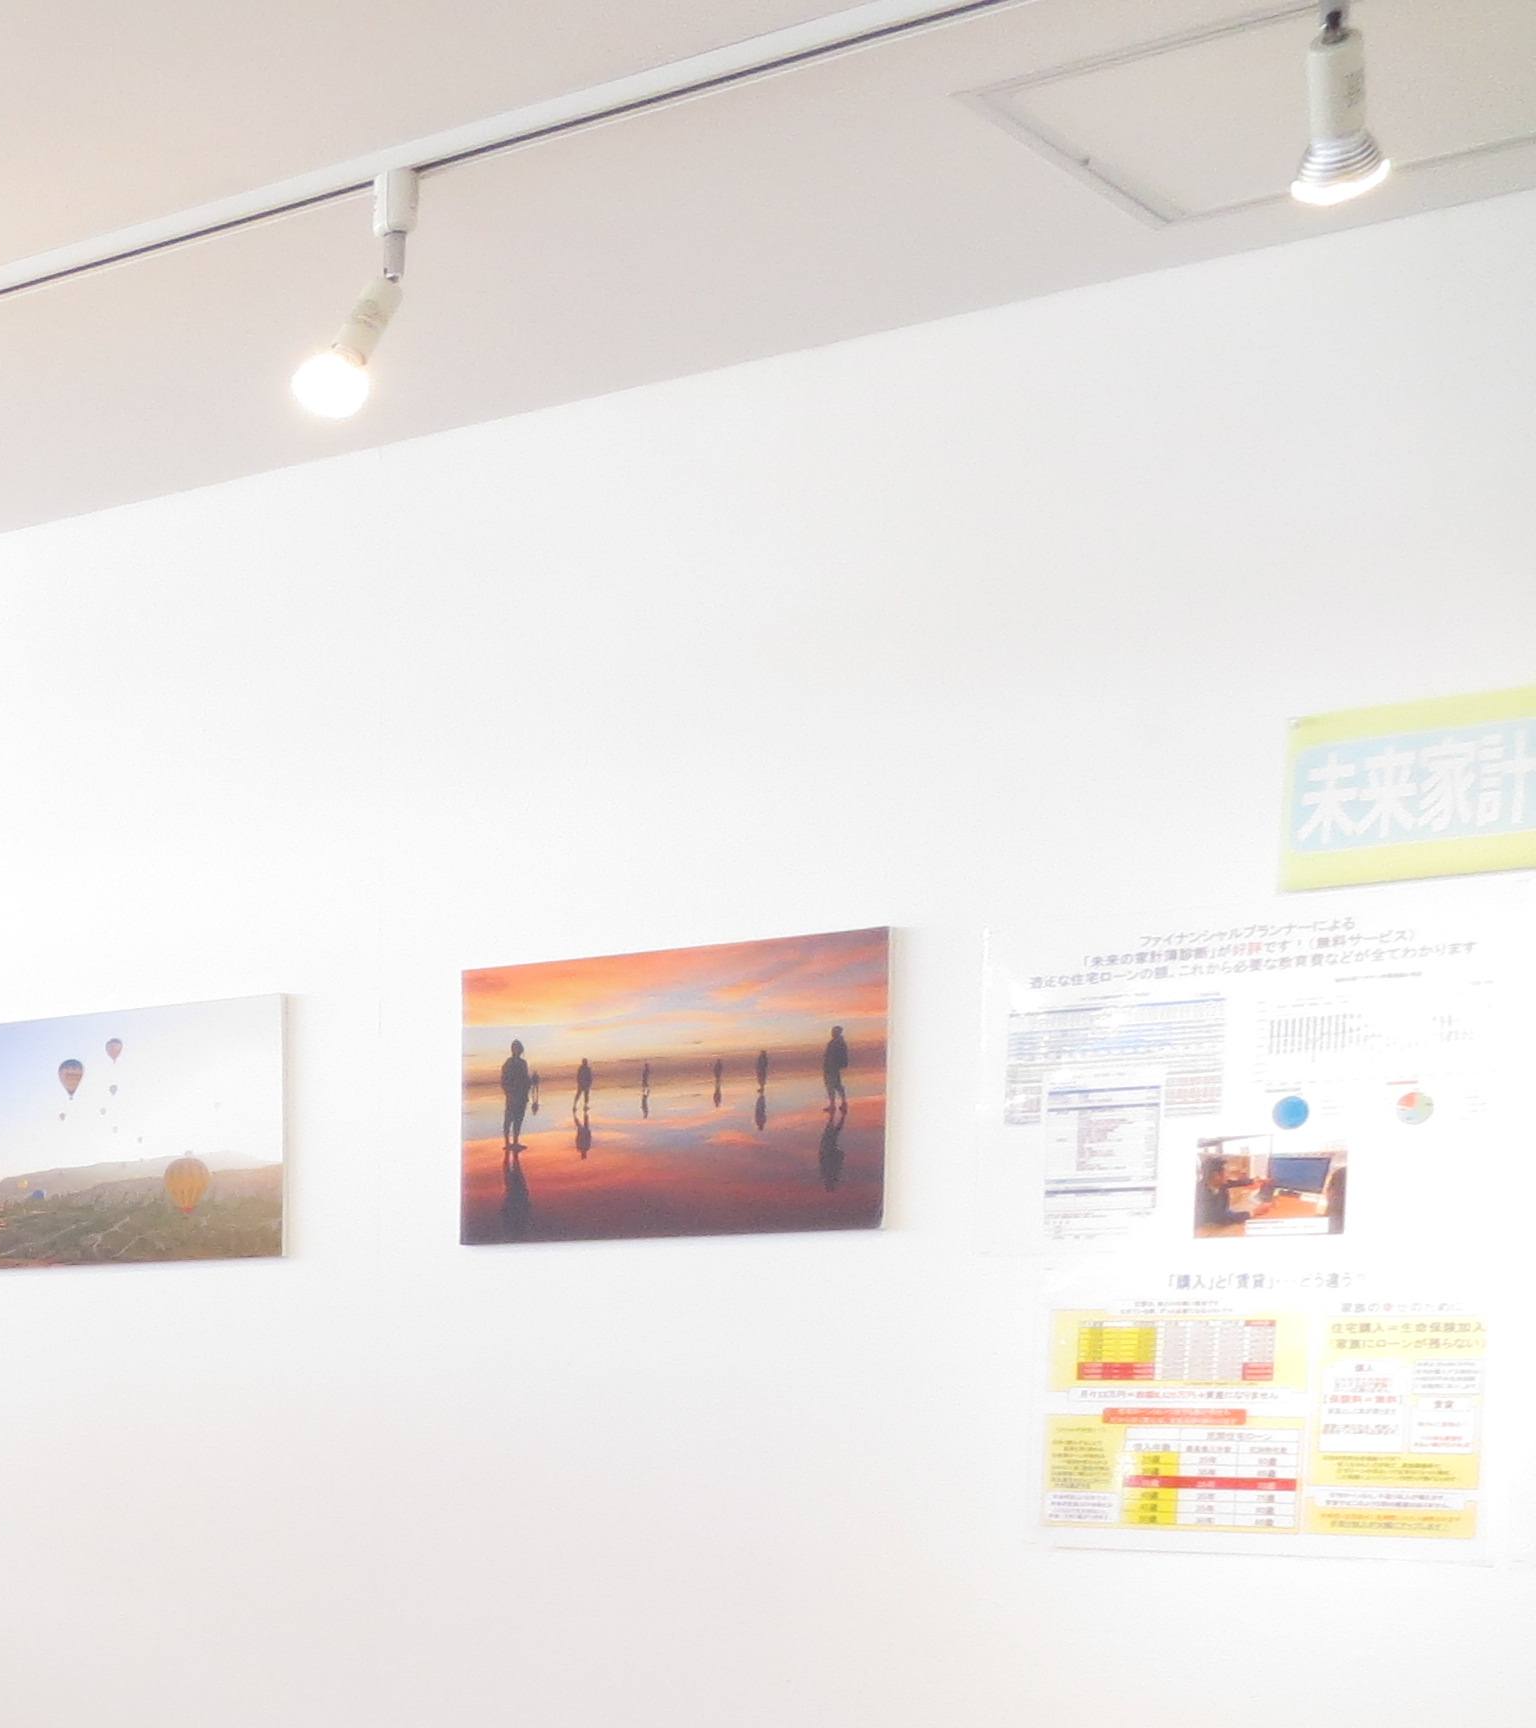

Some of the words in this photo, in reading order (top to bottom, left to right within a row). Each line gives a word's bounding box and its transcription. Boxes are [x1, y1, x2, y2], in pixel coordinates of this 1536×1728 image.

[1298, 730, 1536, 843] 未来家計
[1139, 916, 1356, 947] ファイナンシャルプランナーによる
